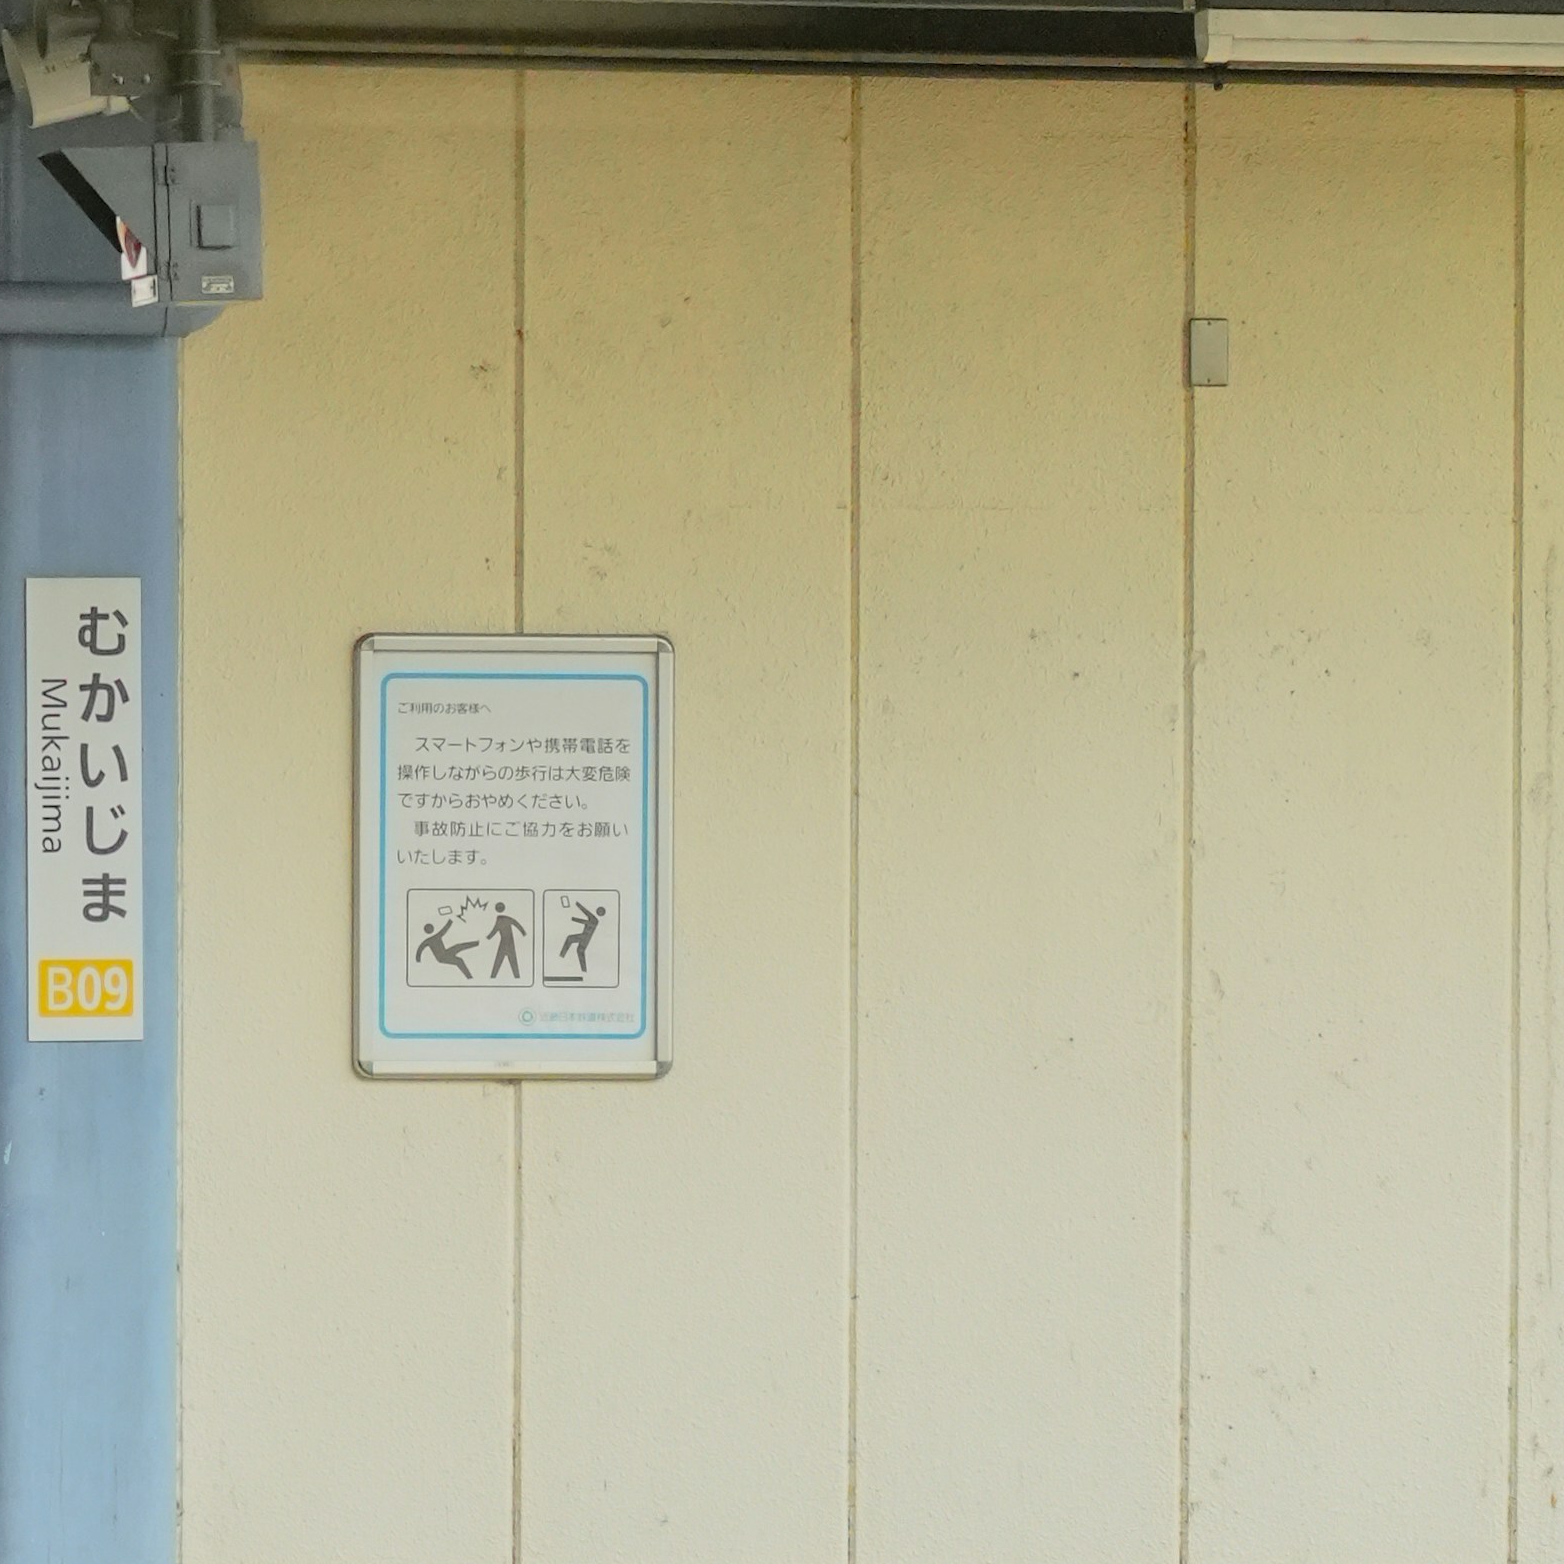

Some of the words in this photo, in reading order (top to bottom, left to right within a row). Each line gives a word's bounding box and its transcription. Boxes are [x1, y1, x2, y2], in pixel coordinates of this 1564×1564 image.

[397, 702, 492, 715] ご利用のお客様へ
[415, 737, 631, 754] スマートフォンや携帯電話を
[34, 677, 70, 854] Mukaijima
[77, 605, 130, 923] むかいじま
[397, 764, 631, 782] 操作しながらの歩行は大変危険
[397, 792, 588, 810] ですからおやめください。
[414, 820, 629, 838] 事故防止にご協力をお願い
[396, 848, 489, 865] いたします。
[47, 968, 128, 1011] B09
